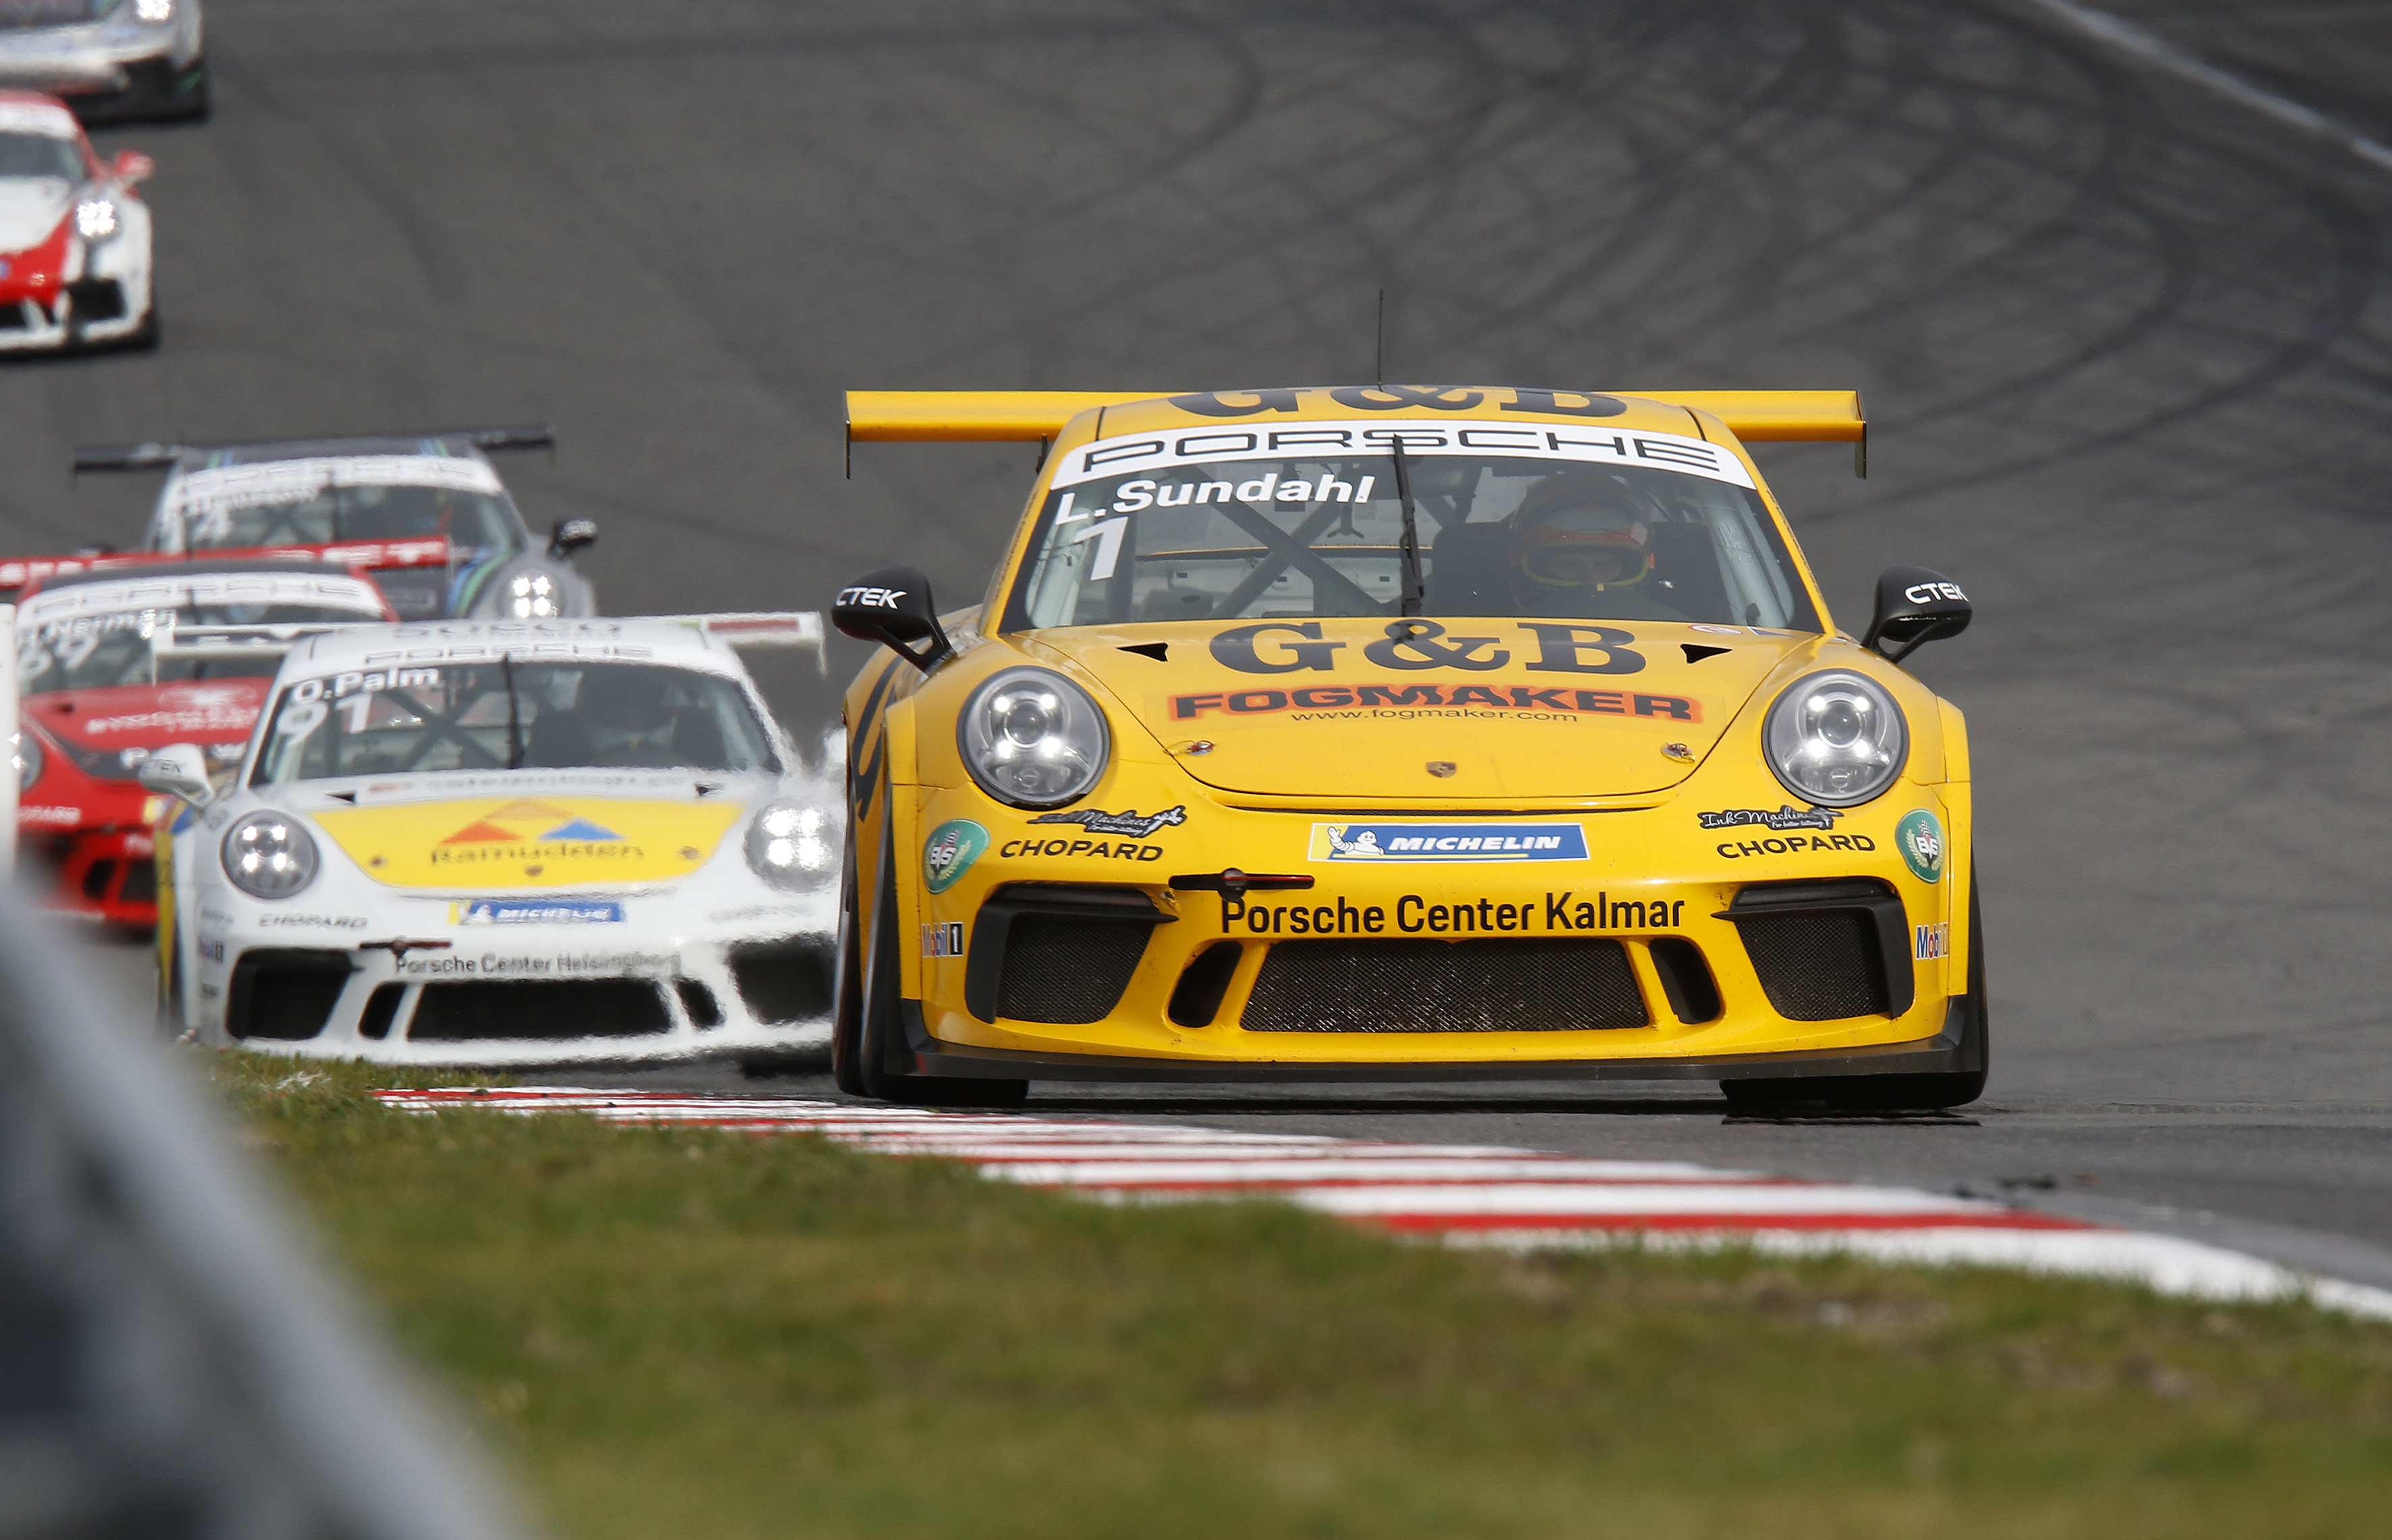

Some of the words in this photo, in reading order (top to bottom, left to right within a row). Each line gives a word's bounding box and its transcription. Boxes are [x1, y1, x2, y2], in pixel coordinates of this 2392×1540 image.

[1083, 429, 1720, 473] PORSCHE
[1055, 473, 1375, 525] L.Sundahl
[1075, 516, 1129, 581] 1
[835, 587, 907, 610] CTEK
[1905, 582, 1969, 604] CTEK
[365, 642, 653, 664] PORSCHE
[1209, 618, 1647, 675] G&B
[292, 667, 440, 703] O.Palm
[1173, 683, 1695, 721] FOGMAKER
[277, 693, 371, 747] 91
[1291, 708, 1578, 723] www.fogmaker.com
[1702, 812, 1736, 827] Ink
[1000, 839, 1163, 861] CHOPARD
[1388, 836, 1562, 852] MICHELIN
[1716, 834, 1876, 859] CHOPARD
[1222, 896, 1385, 934] Porsche
[1397, 895, 1534, 932] Center
[1545, 891, 1684, 929] Kalmar
[395, 955, 475, 974] Porsche
[481, 953, 552, 974] Center
